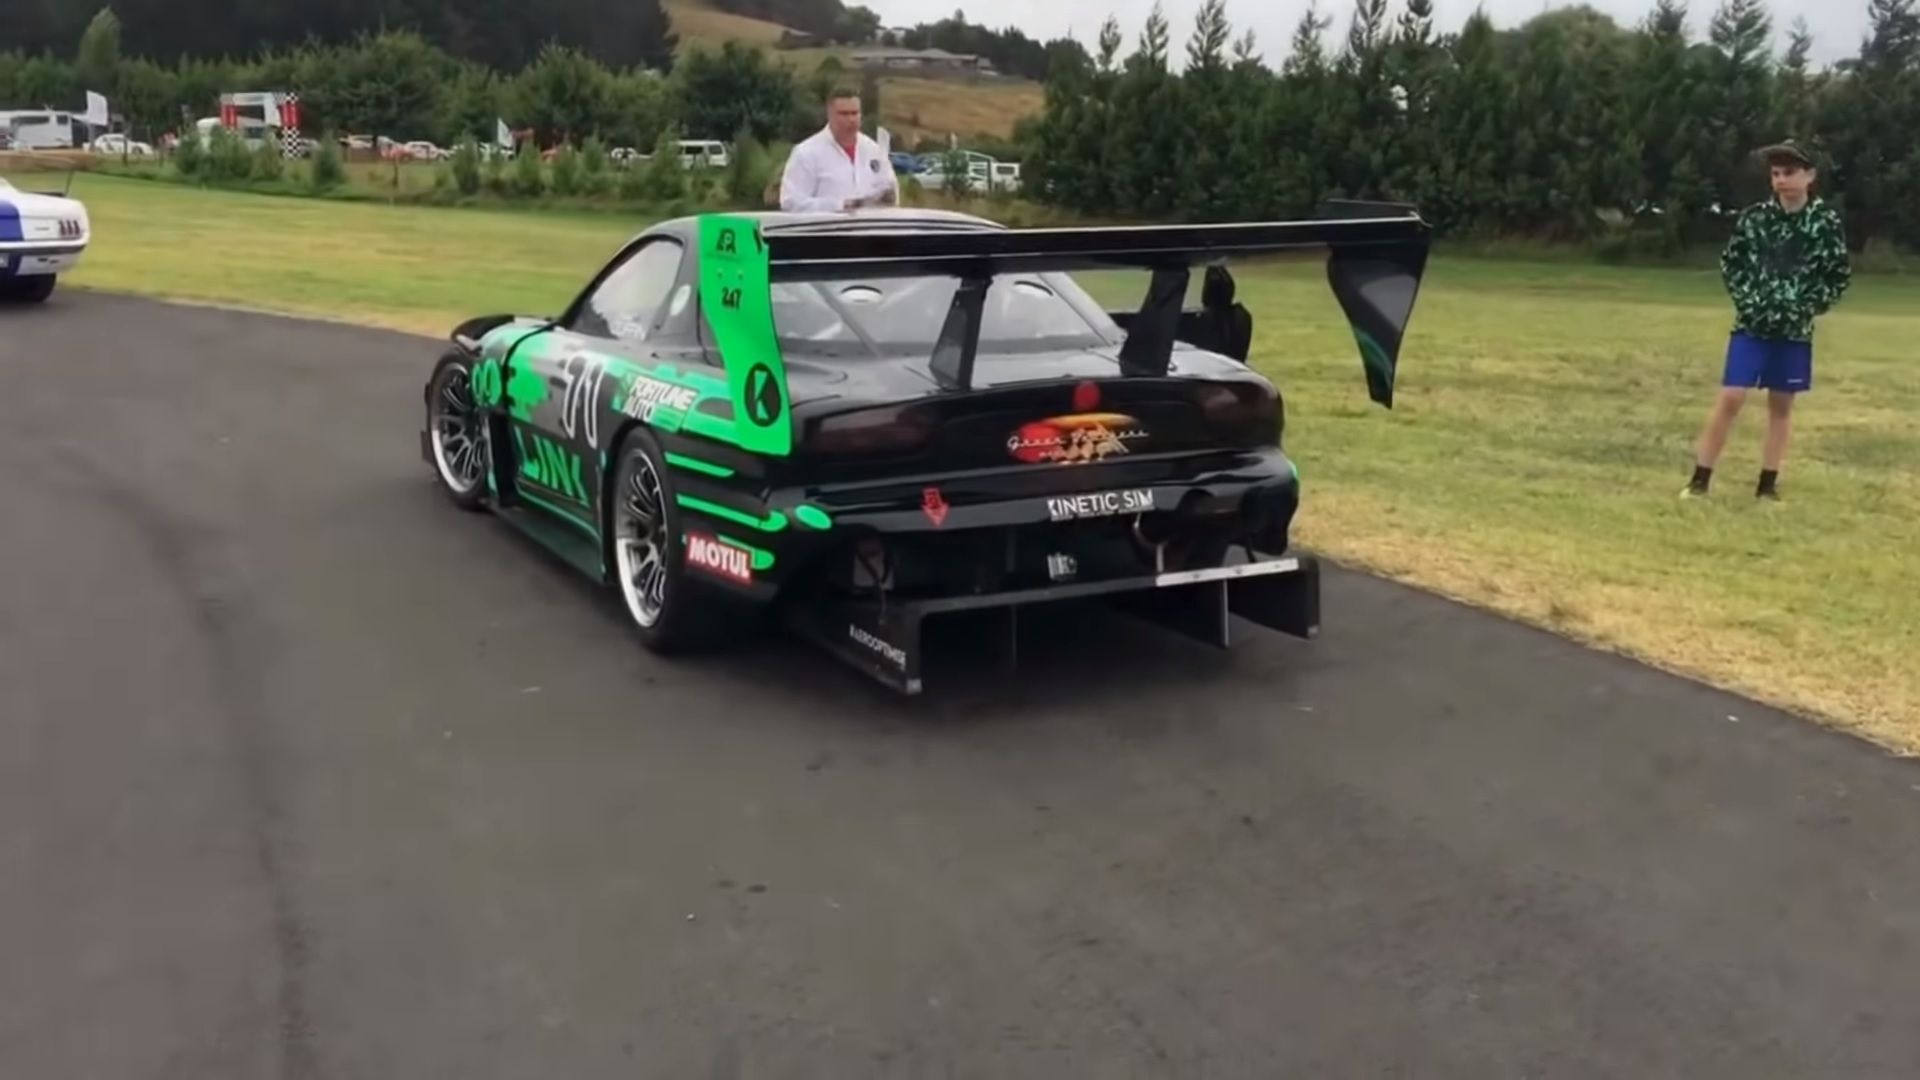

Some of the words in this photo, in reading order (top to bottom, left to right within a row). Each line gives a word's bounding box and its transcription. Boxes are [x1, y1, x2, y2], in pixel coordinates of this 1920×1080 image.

[1048, 492, 1119, 517] KINETIC
[1122, 488, 1154, 511] SIM
[688, 536, 750, 579] MOTUL
